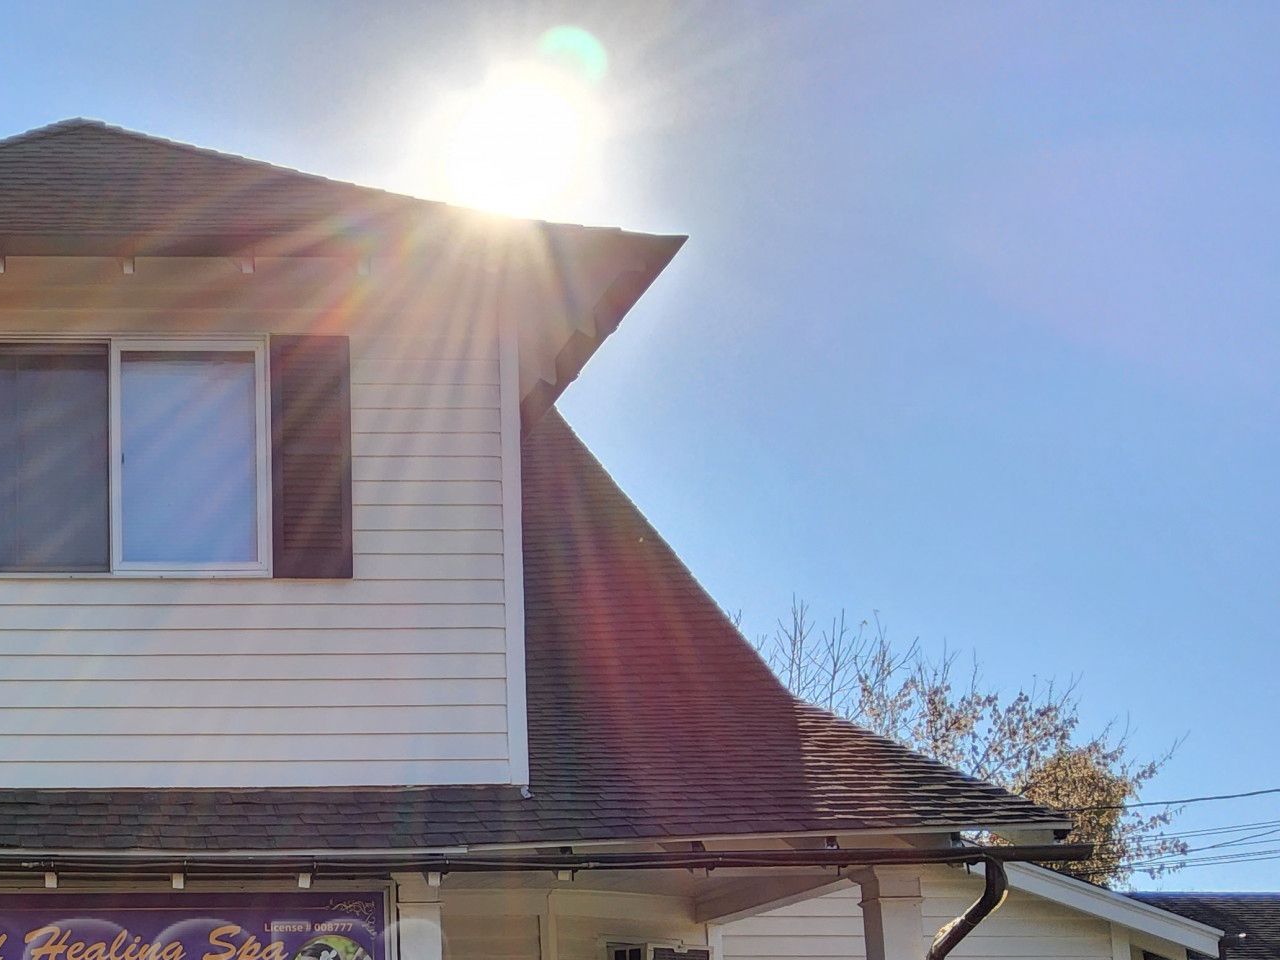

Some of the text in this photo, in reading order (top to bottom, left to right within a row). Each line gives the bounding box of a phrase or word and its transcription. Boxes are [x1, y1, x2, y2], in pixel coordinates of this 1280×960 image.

[264, 921, 353, 933] License # 008777
